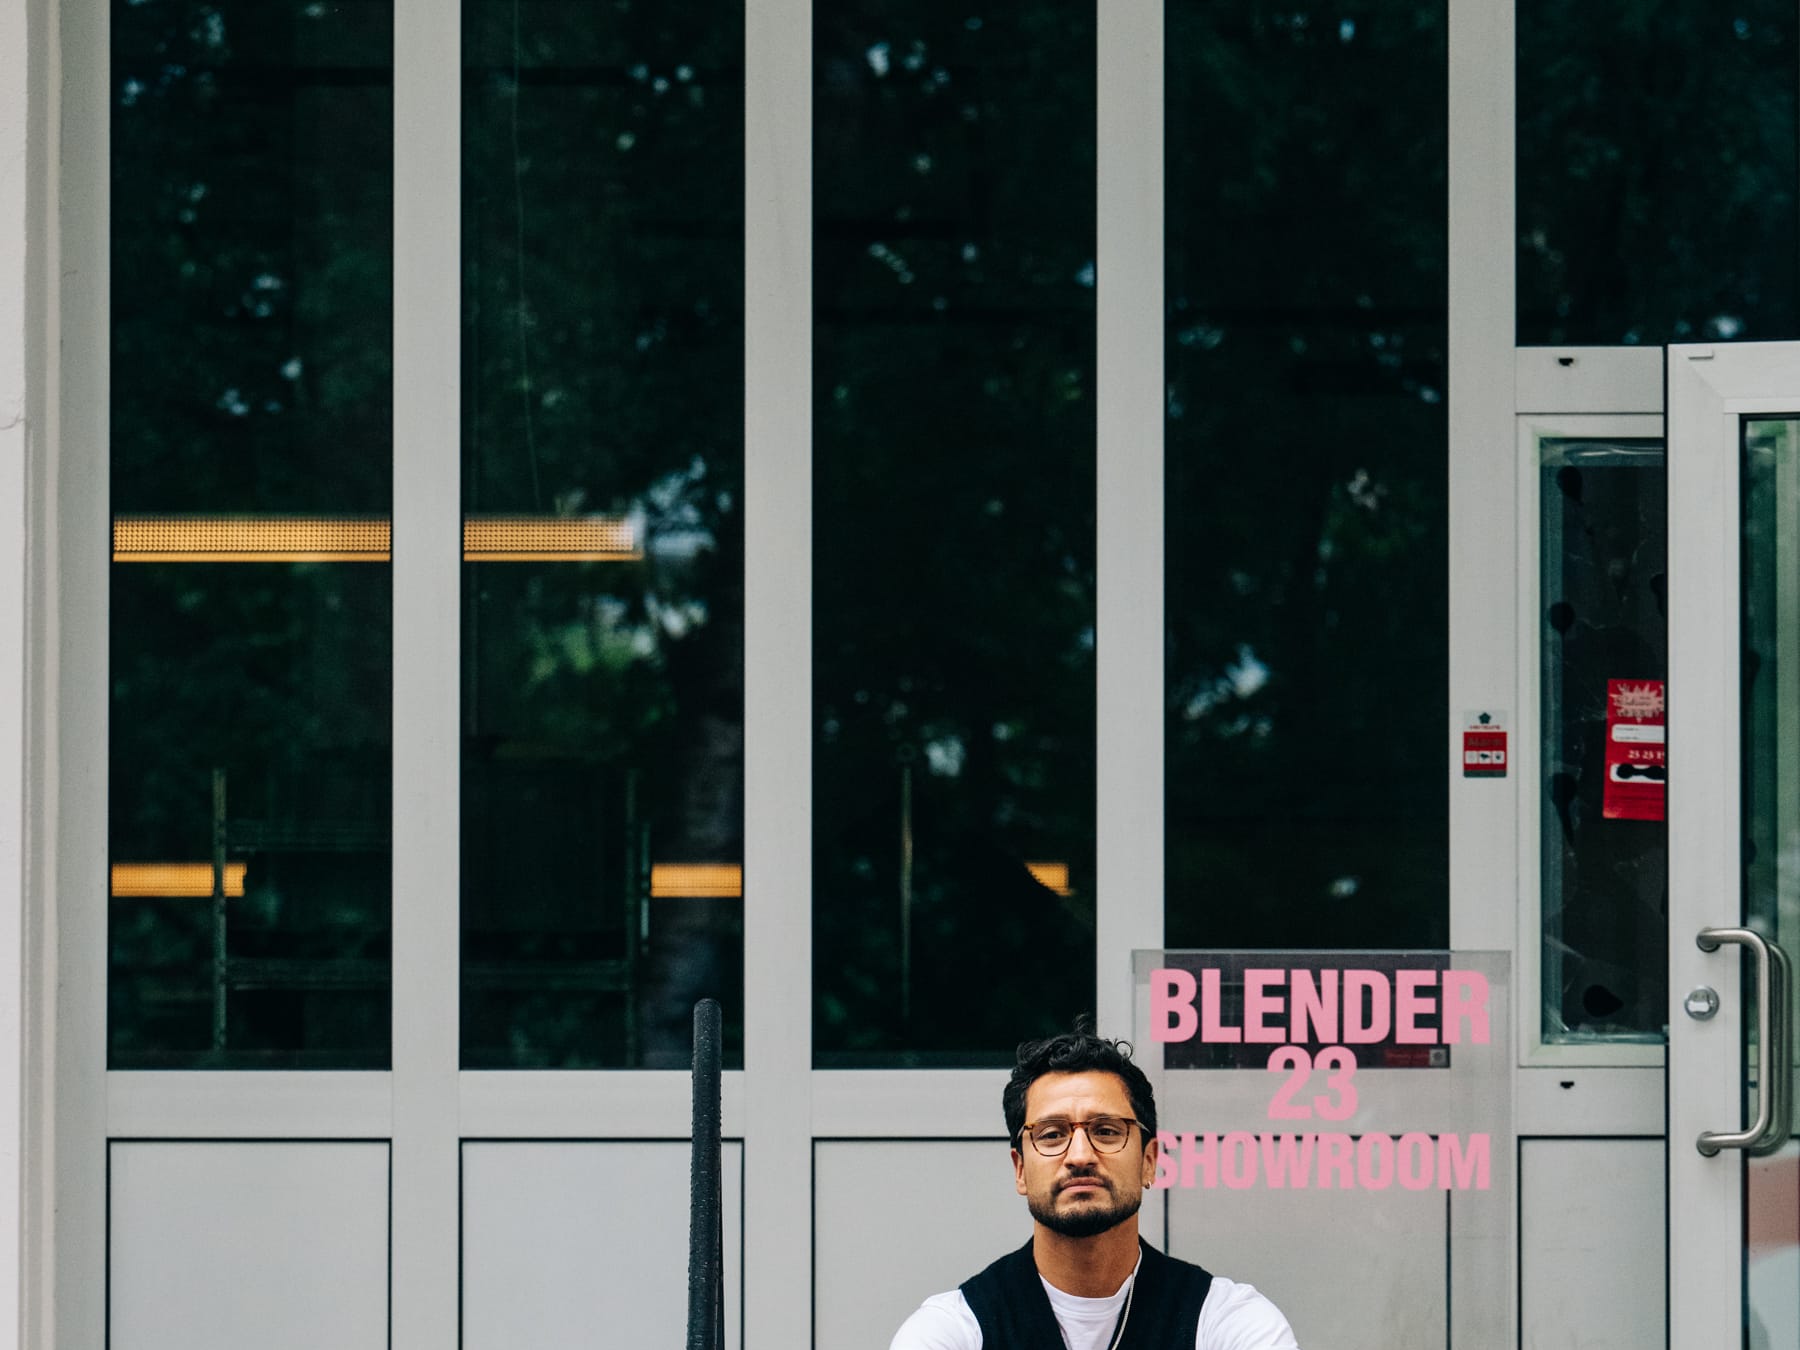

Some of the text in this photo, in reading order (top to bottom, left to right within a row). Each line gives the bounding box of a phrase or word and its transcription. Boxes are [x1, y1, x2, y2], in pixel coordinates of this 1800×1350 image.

[1151, 968, 1490, 1045] BLENDER
[1267, 1046, 1358, 1121] 23
[1154, 1130, 1490, 1190] SHOWROOM
